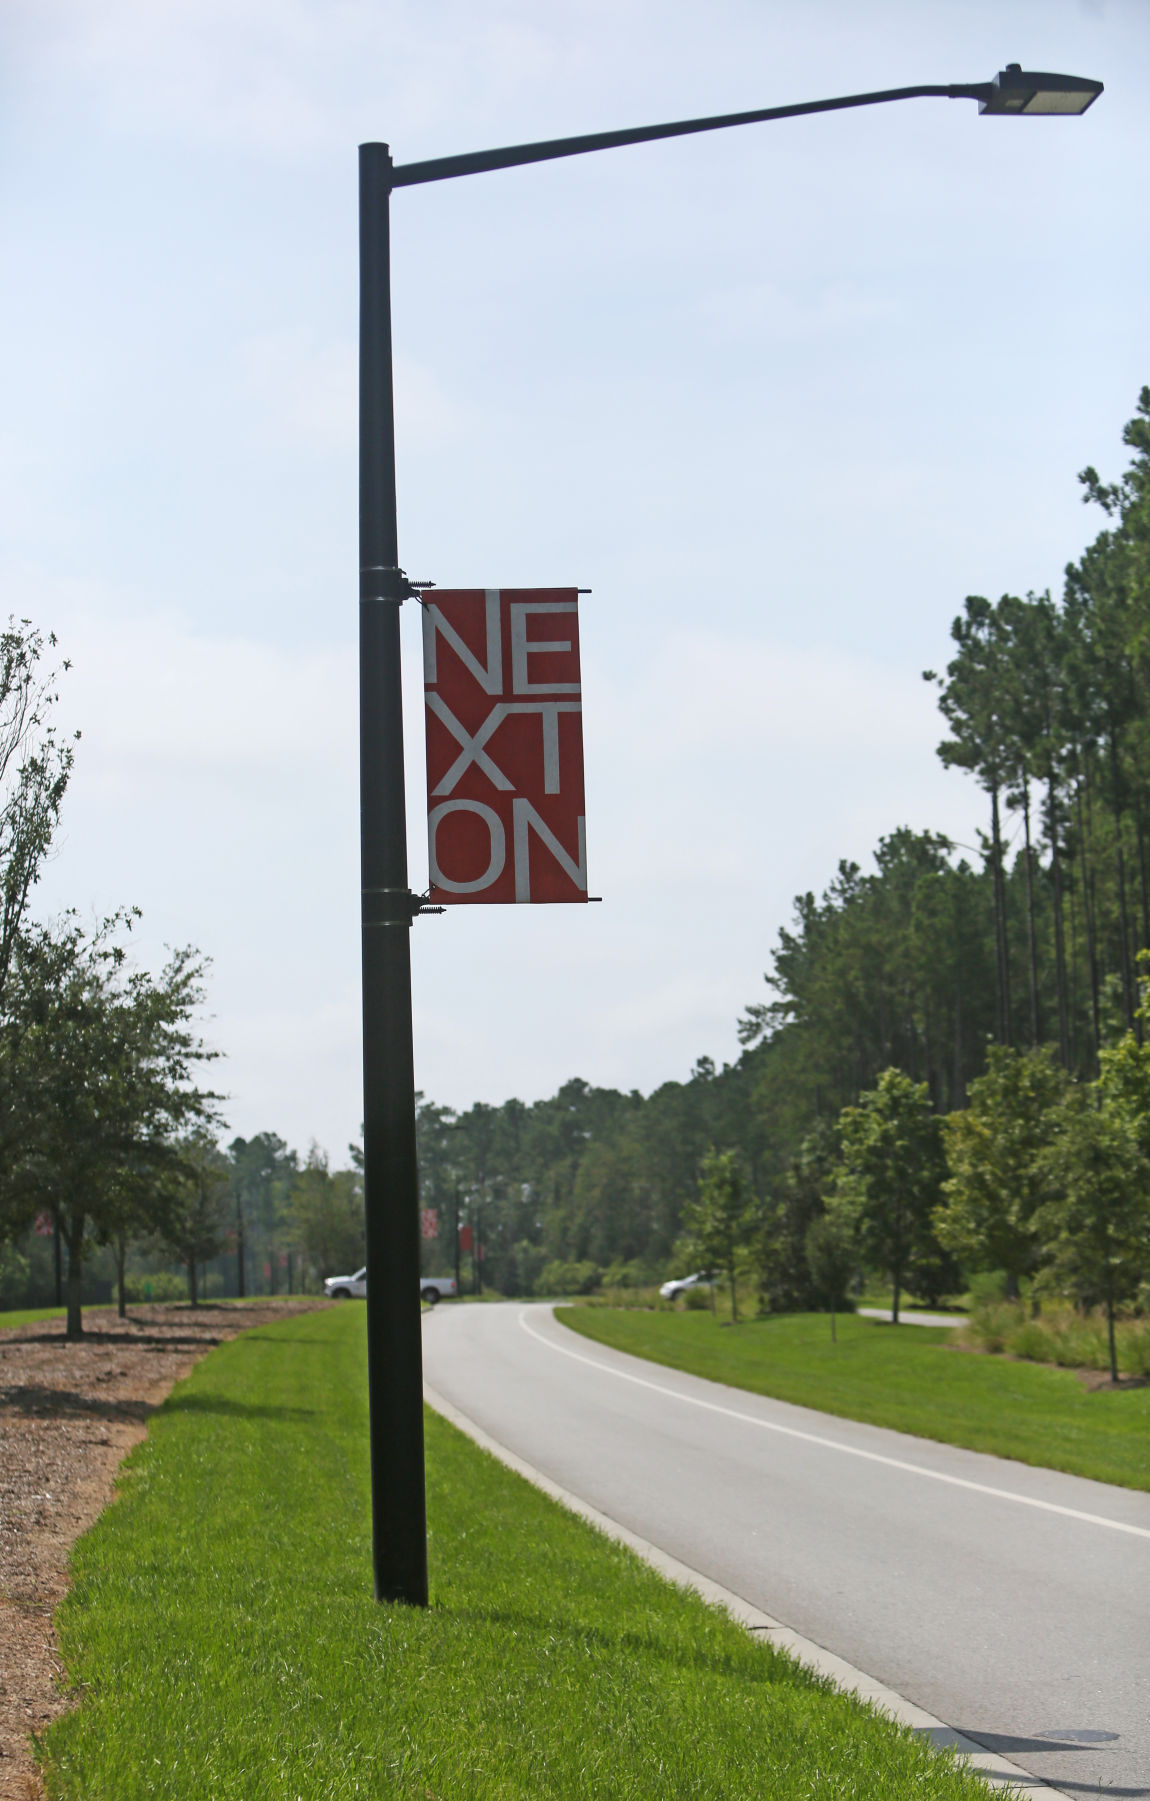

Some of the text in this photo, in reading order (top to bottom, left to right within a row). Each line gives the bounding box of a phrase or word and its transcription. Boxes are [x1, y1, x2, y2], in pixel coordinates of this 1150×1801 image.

[422, 589, 581, 695] NE
[425, 691, 582, 796] XT
[428, 798, 588, 904] ON
